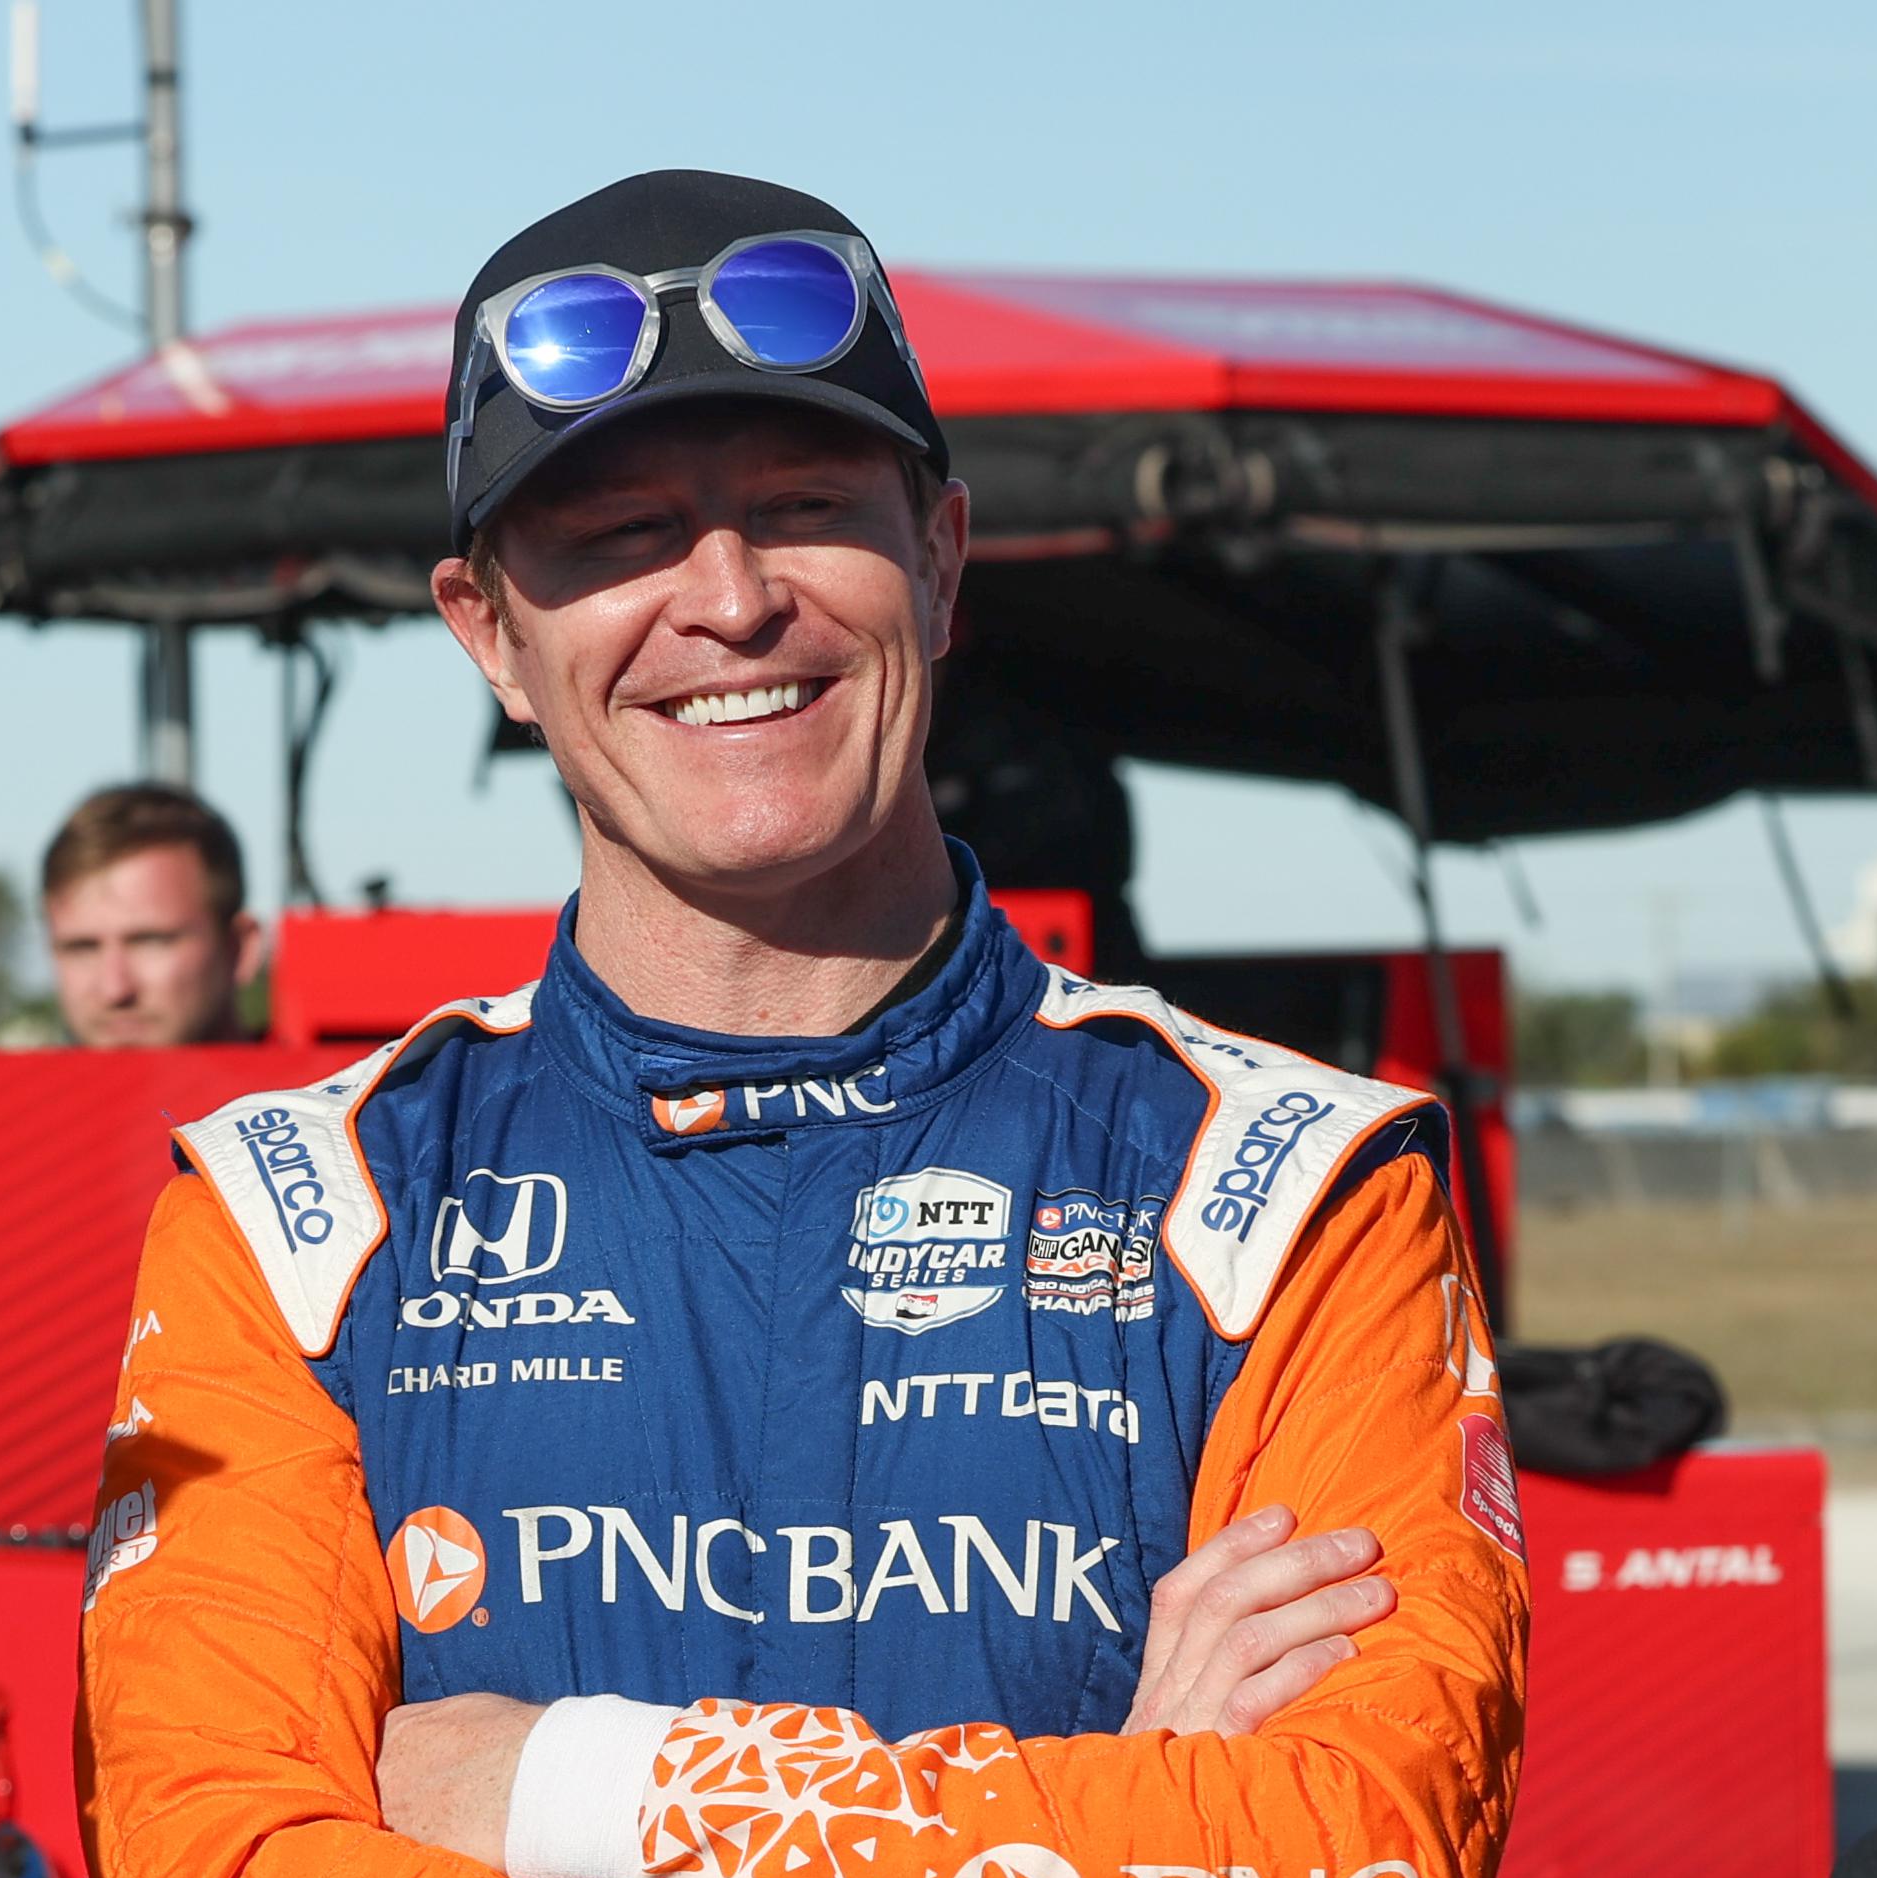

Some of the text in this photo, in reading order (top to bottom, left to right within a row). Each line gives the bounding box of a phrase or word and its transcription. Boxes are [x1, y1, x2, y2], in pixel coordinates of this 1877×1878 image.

[743, 1065, 897, 1120] PNC
[238, 1108, 334, 1249] sparco
[1201, 1091, 1327, 1237] sparco
[917, 1201, 994, 1227] NTT
[848, 1243, 1006, 1274] INDYCAR
[1030, 1235, 1059, 1260] CHIP
[872, 1269, 966, 1289] SERIES
[396, 1289, 636, 1331] ONDA
[387, 1357, 624, 1396] CHARD MILLE
[861, 1373, 995, 1426] NTT
